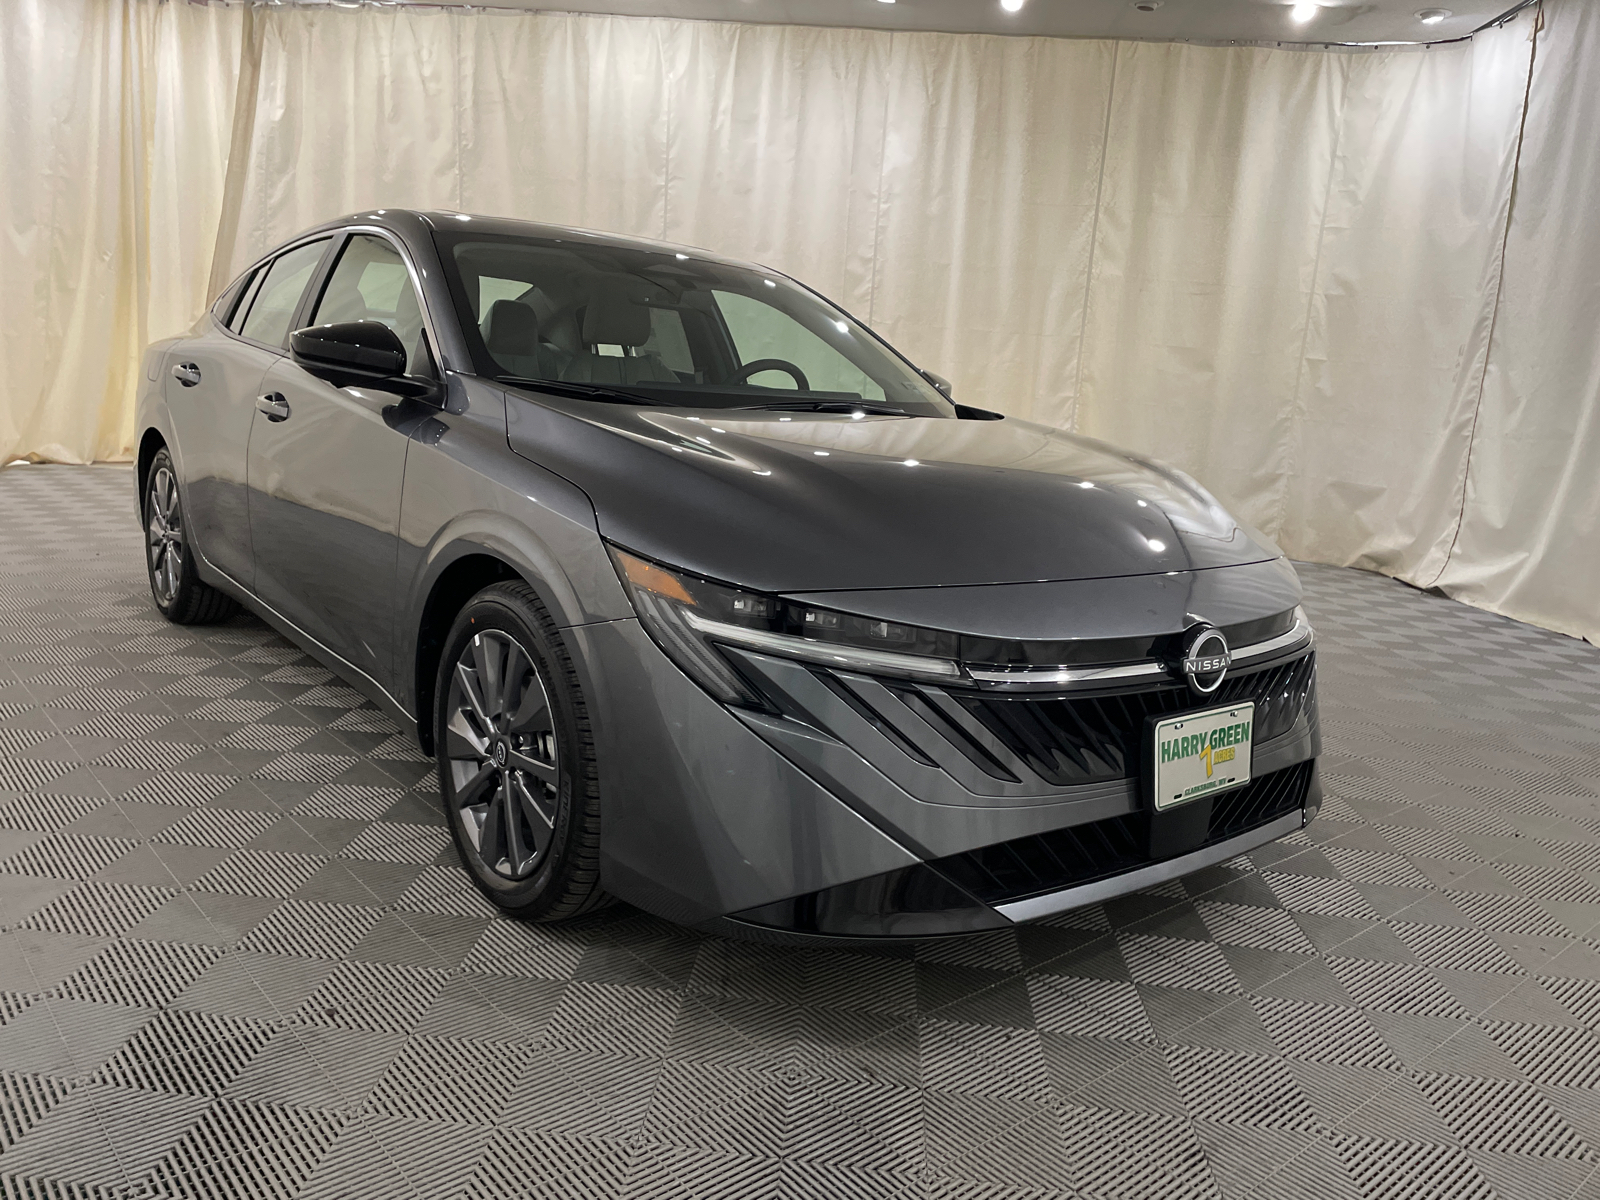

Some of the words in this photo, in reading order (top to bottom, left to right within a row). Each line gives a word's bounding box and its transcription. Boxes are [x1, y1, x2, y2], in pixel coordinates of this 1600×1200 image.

[1186, 656, 1231, 671] NISSAN
[1161, 731, 1208, 763] HARRY
[1209, 721, 1250, 750] GREEN
